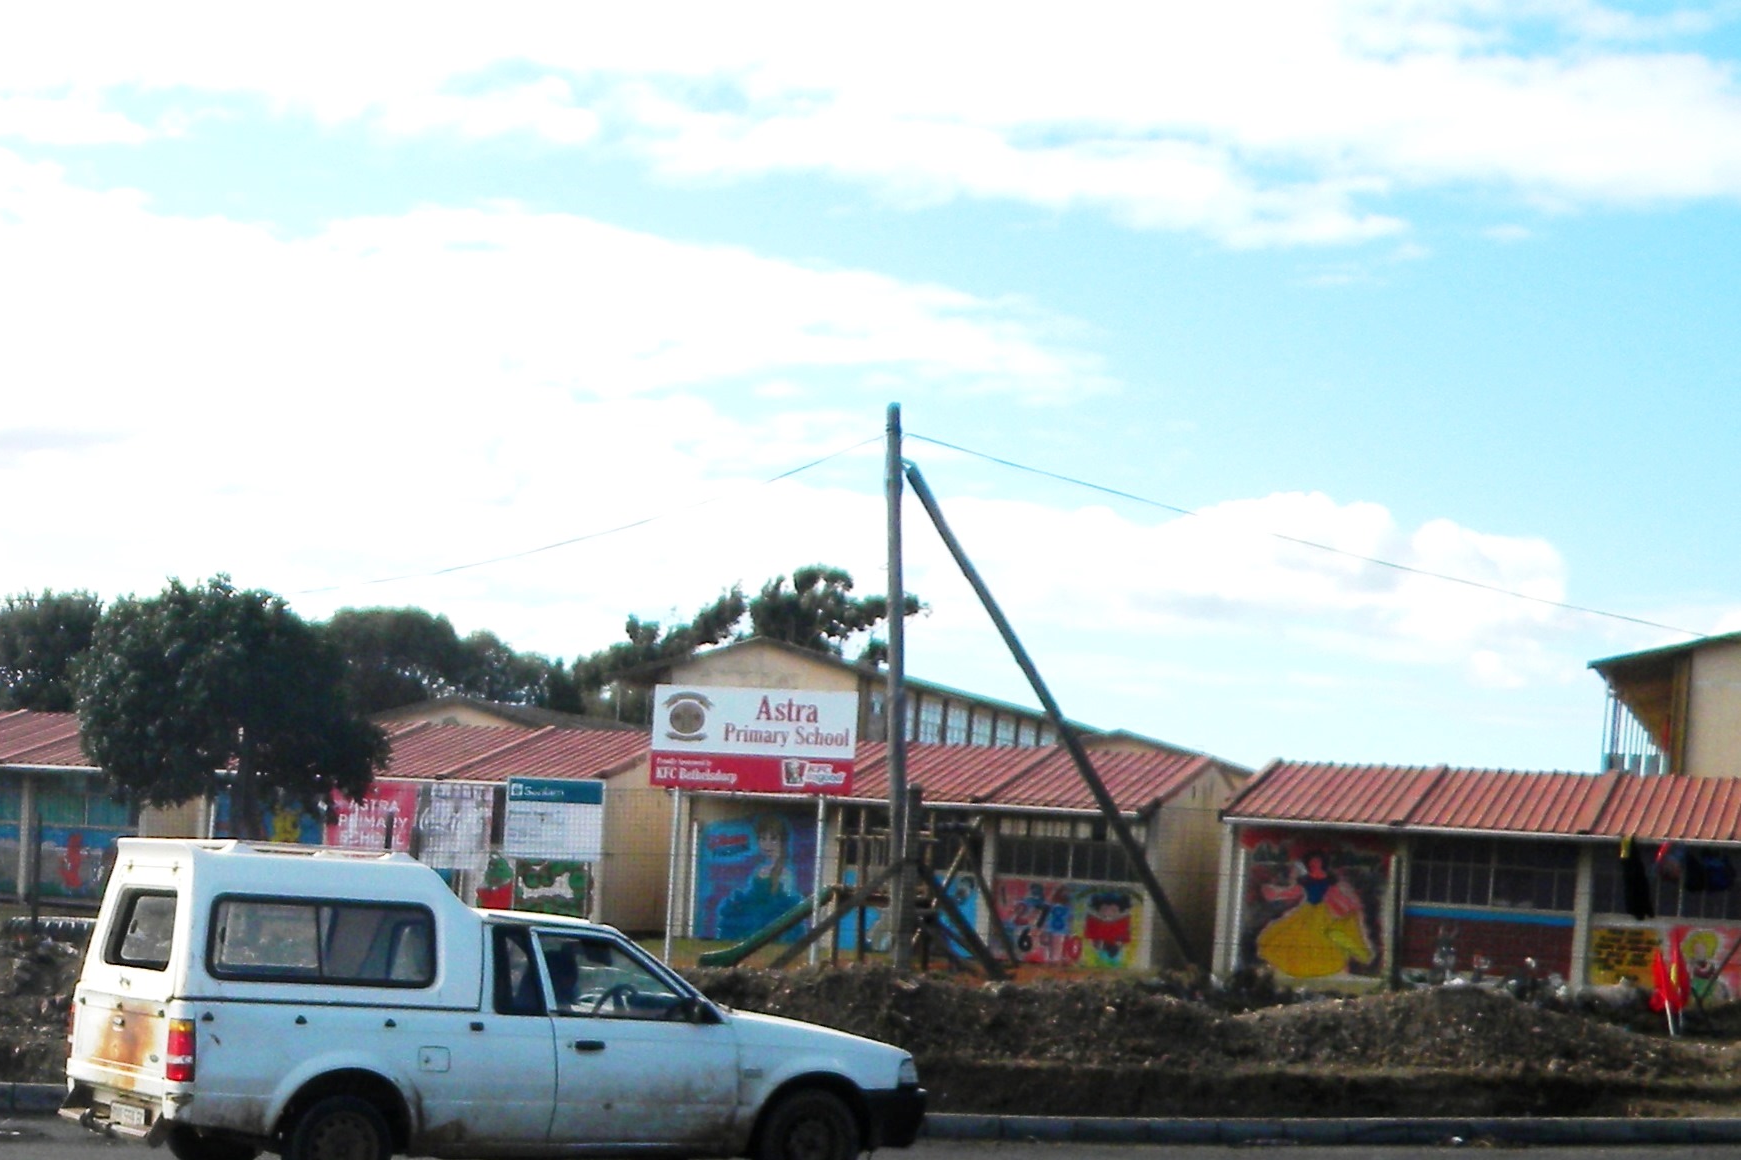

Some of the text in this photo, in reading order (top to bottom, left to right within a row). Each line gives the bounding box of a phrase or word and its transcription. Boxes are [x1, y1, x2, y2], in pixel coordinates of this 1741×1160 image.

[755, 694, 819, 723] Astra
[723, 721, 850, 747] Primary School
[655, 766, 677, 779] KFC
[339, 829, 405, 846] SCHOL
